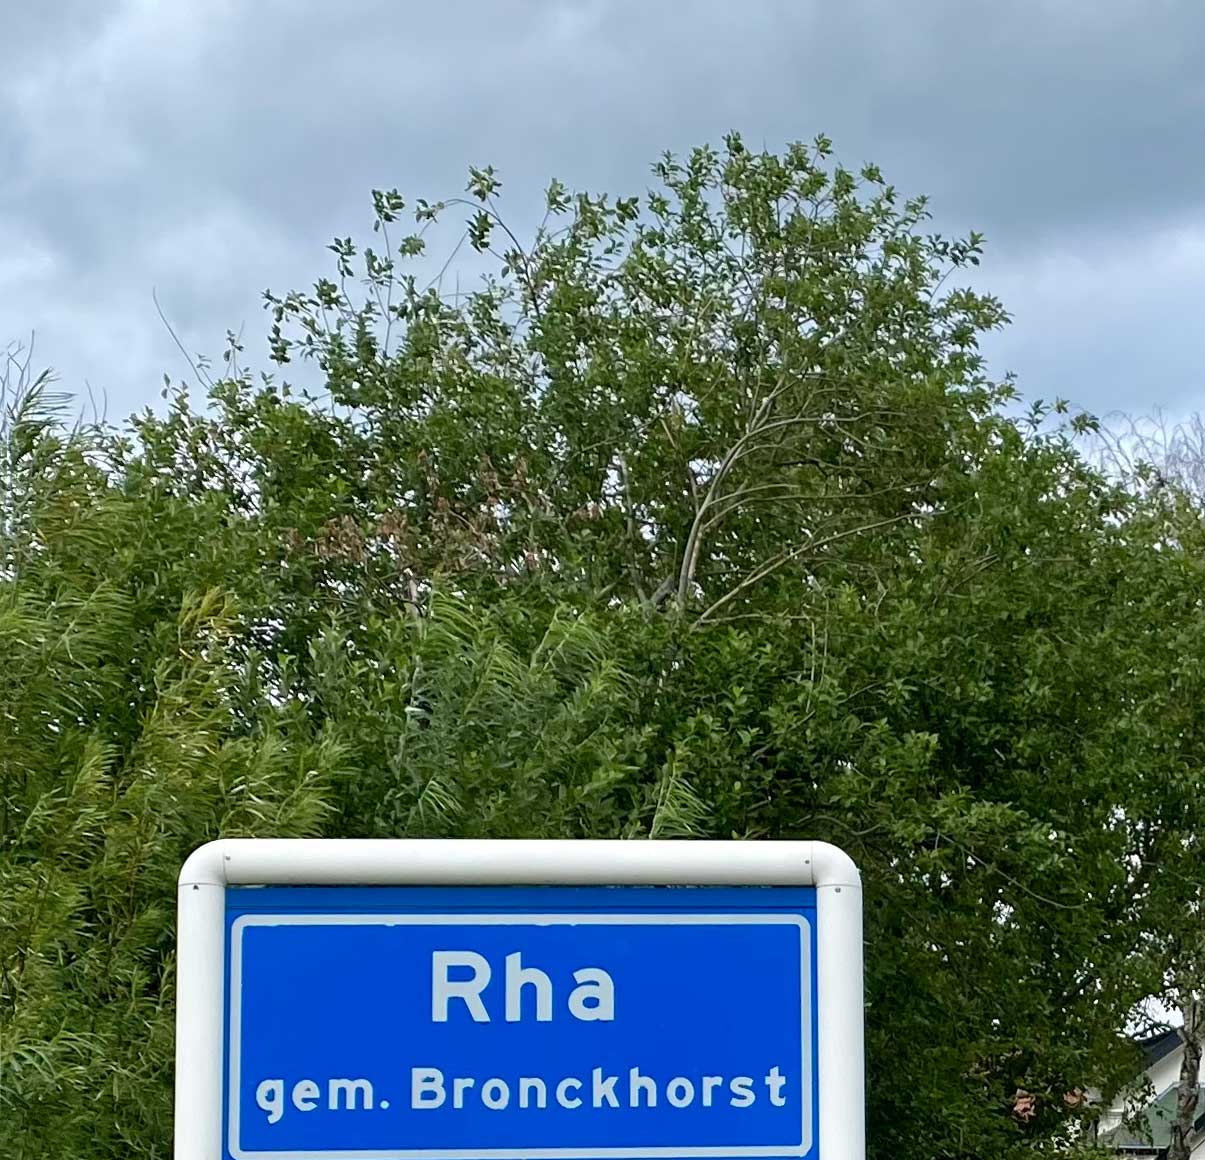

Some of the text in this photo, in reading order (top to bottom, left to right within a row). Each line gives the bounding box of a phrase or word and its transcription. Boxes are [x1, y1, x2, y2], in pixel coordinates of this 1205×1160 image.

[433, 951, 615, 1022] Rha
[256, 1066, 788, 1124] gem. Bronckhorst
